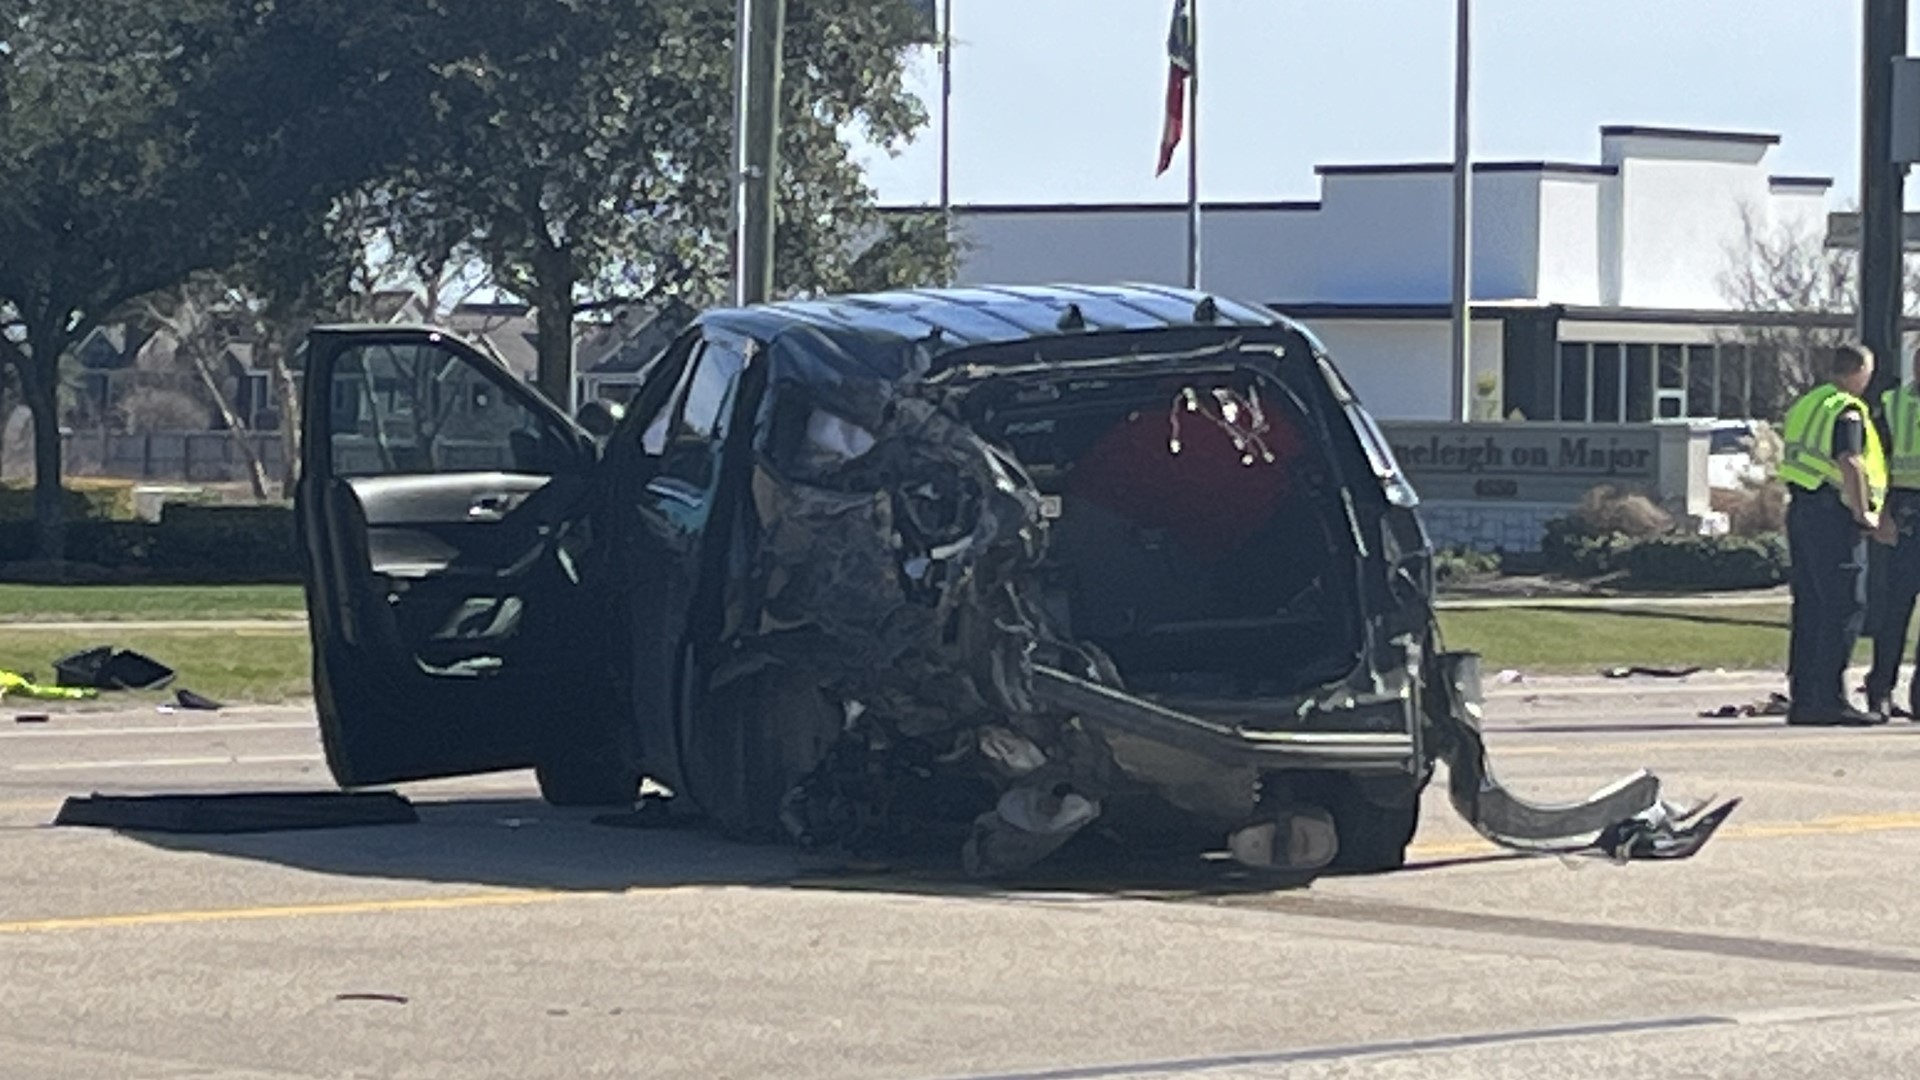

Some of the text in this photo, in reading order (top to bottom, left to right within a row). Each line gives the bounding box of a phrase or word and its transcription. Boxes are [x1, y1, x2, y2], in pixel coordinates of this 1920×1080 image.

[1392, 435, 1650, 475] neleigh on Major
